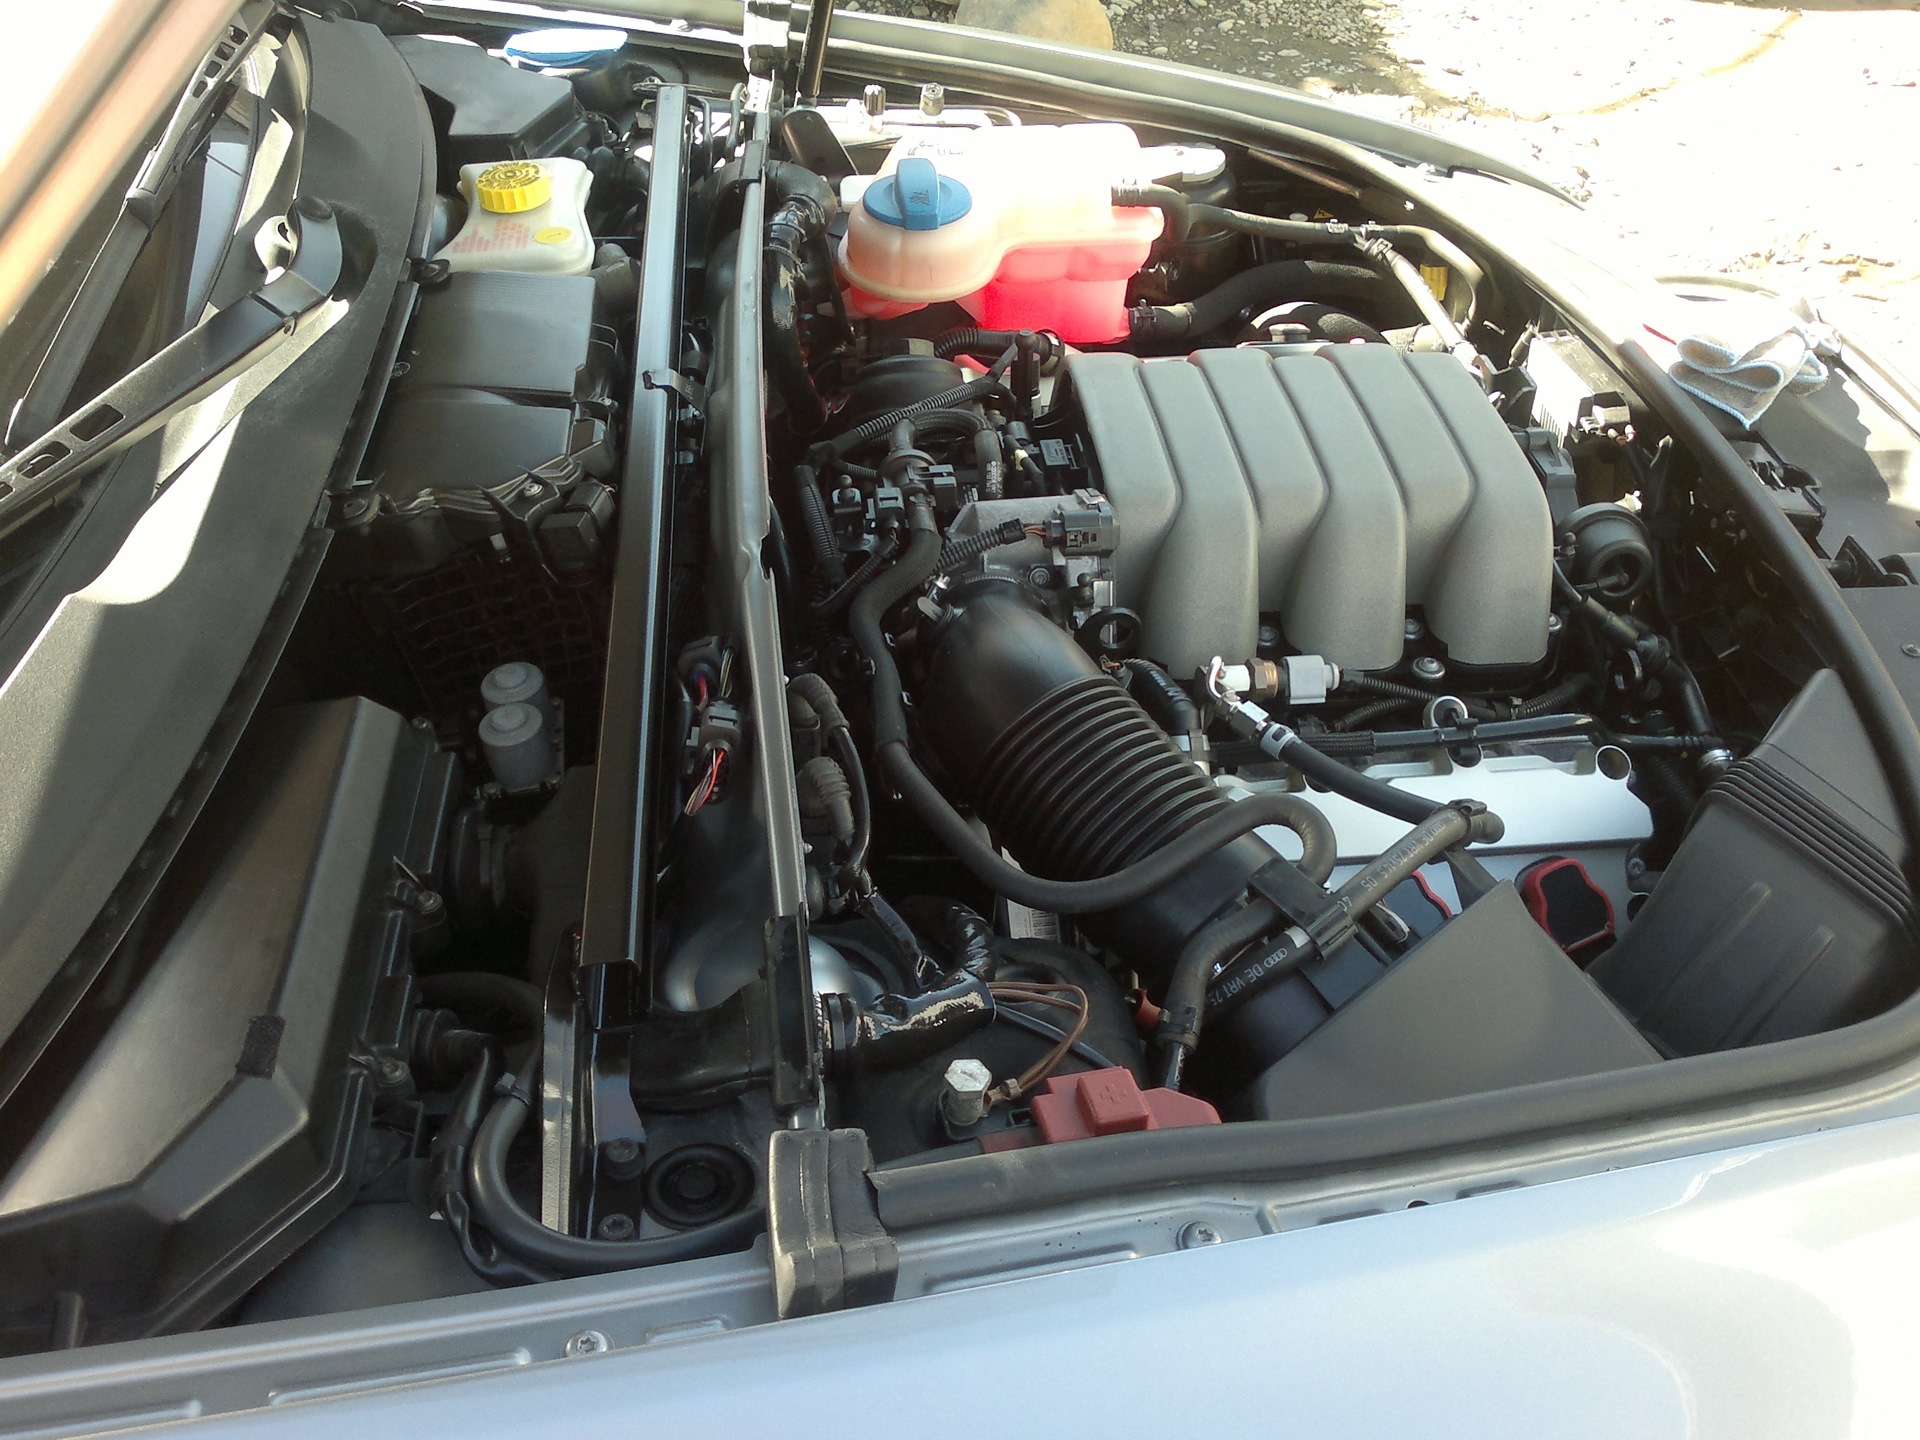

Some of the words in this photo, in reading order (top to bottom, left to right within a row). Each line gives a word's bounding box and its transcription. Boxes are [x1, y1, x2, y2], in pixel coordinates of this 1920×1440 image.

[1361, 876, 1378, 891] 05
[1244, 963, 1264, 983] DE
[1222, 976, 1245, 998] VRT
